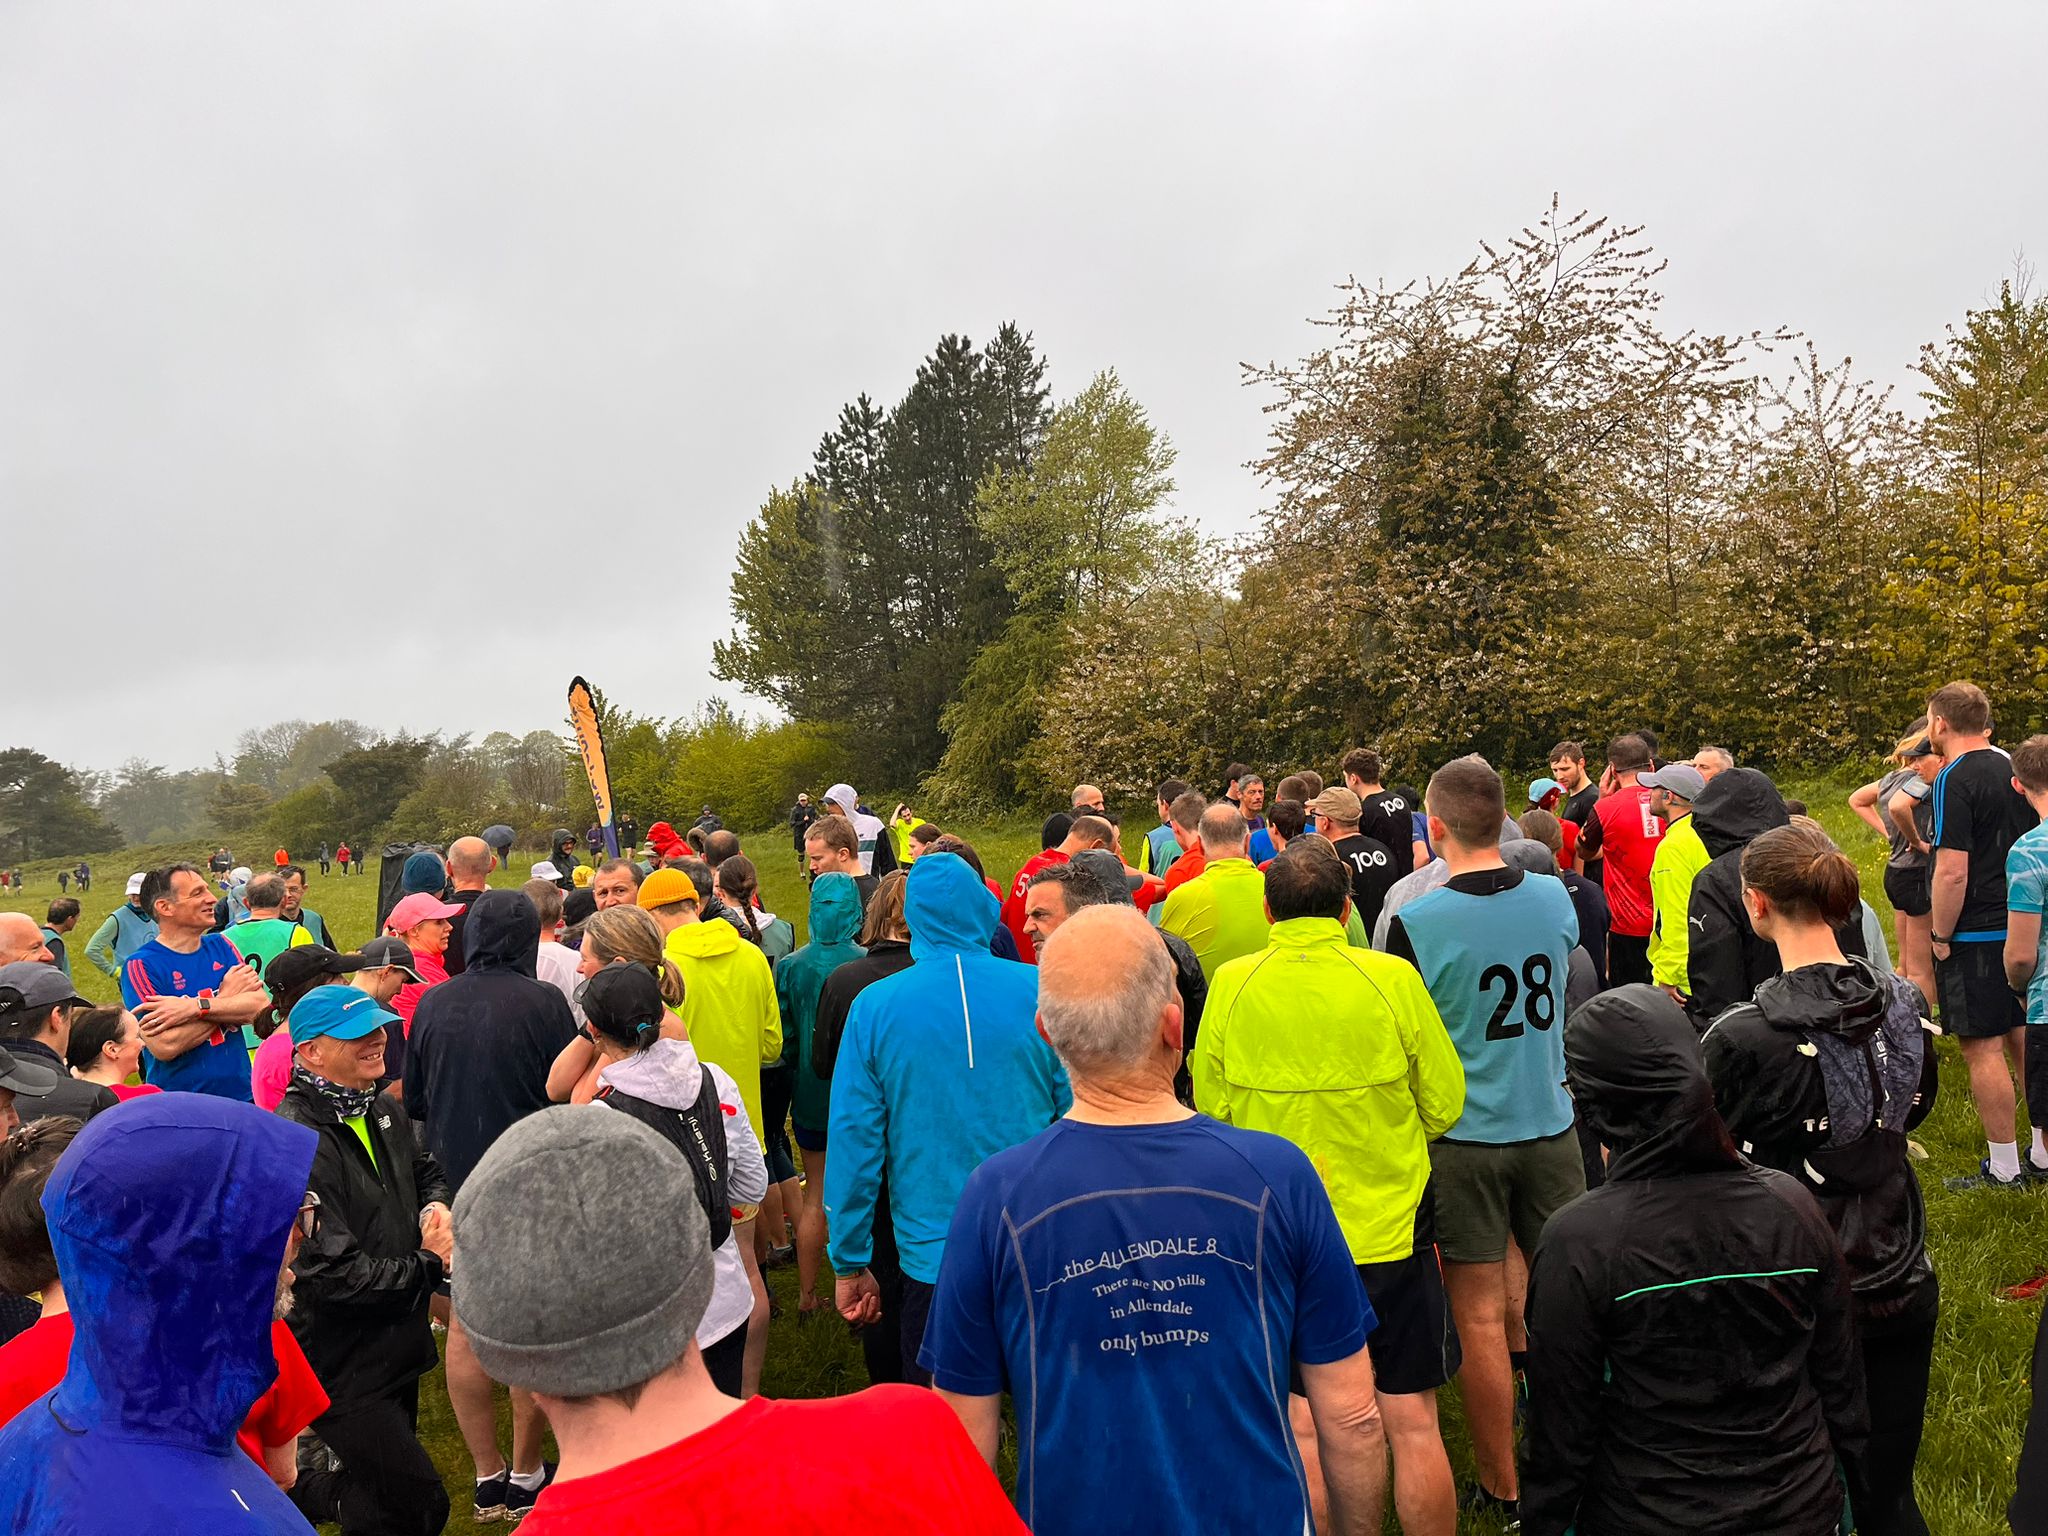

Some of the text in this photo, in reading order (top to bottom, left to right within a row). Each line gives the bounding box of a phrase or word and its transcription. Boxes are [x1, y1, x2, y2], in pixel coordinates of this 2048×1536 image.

[1379, 797, 1405, 817] 100
[1349, 850, 1387, 874] 100
[1015, 872, 1031, 898] 5
[1478, 952, 1555, 1042] 28
[1064, 1237, 1217, 1278] the ALLENDALE 8
[1092, 1273, 1206, 1298] There are NO hills
[1110, 1298, 1193, 1319] in Allendale
[1100, 1328, 1210, 1356] only bumps
